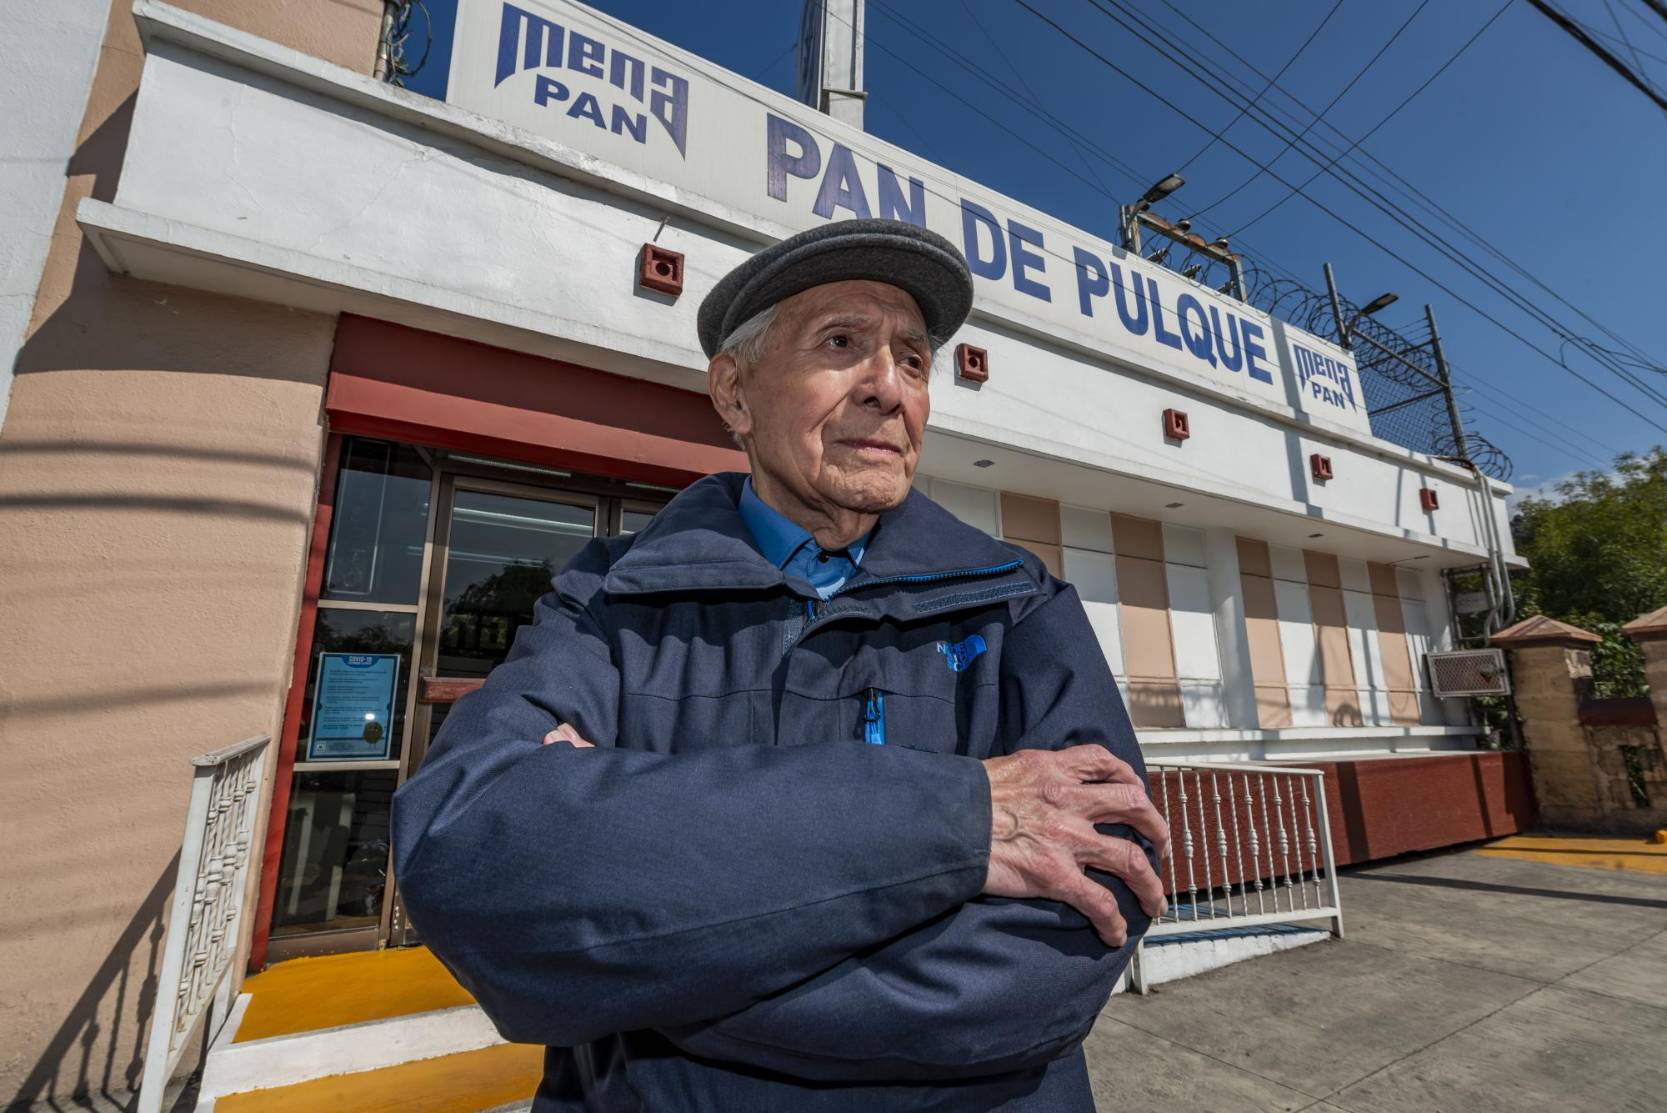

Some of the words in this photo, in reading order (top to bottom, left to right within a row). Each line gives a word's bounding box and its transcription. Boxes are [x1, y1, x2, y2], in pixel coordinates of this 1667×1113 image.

[534, 73, 647, 144] PAN
[767, 112, 927, 229] PAN
[960, 197, 1052, 303] DE
[1072, 246, 1273, 385] PULQUE
[1311, 381, 1346, 410] PAN
